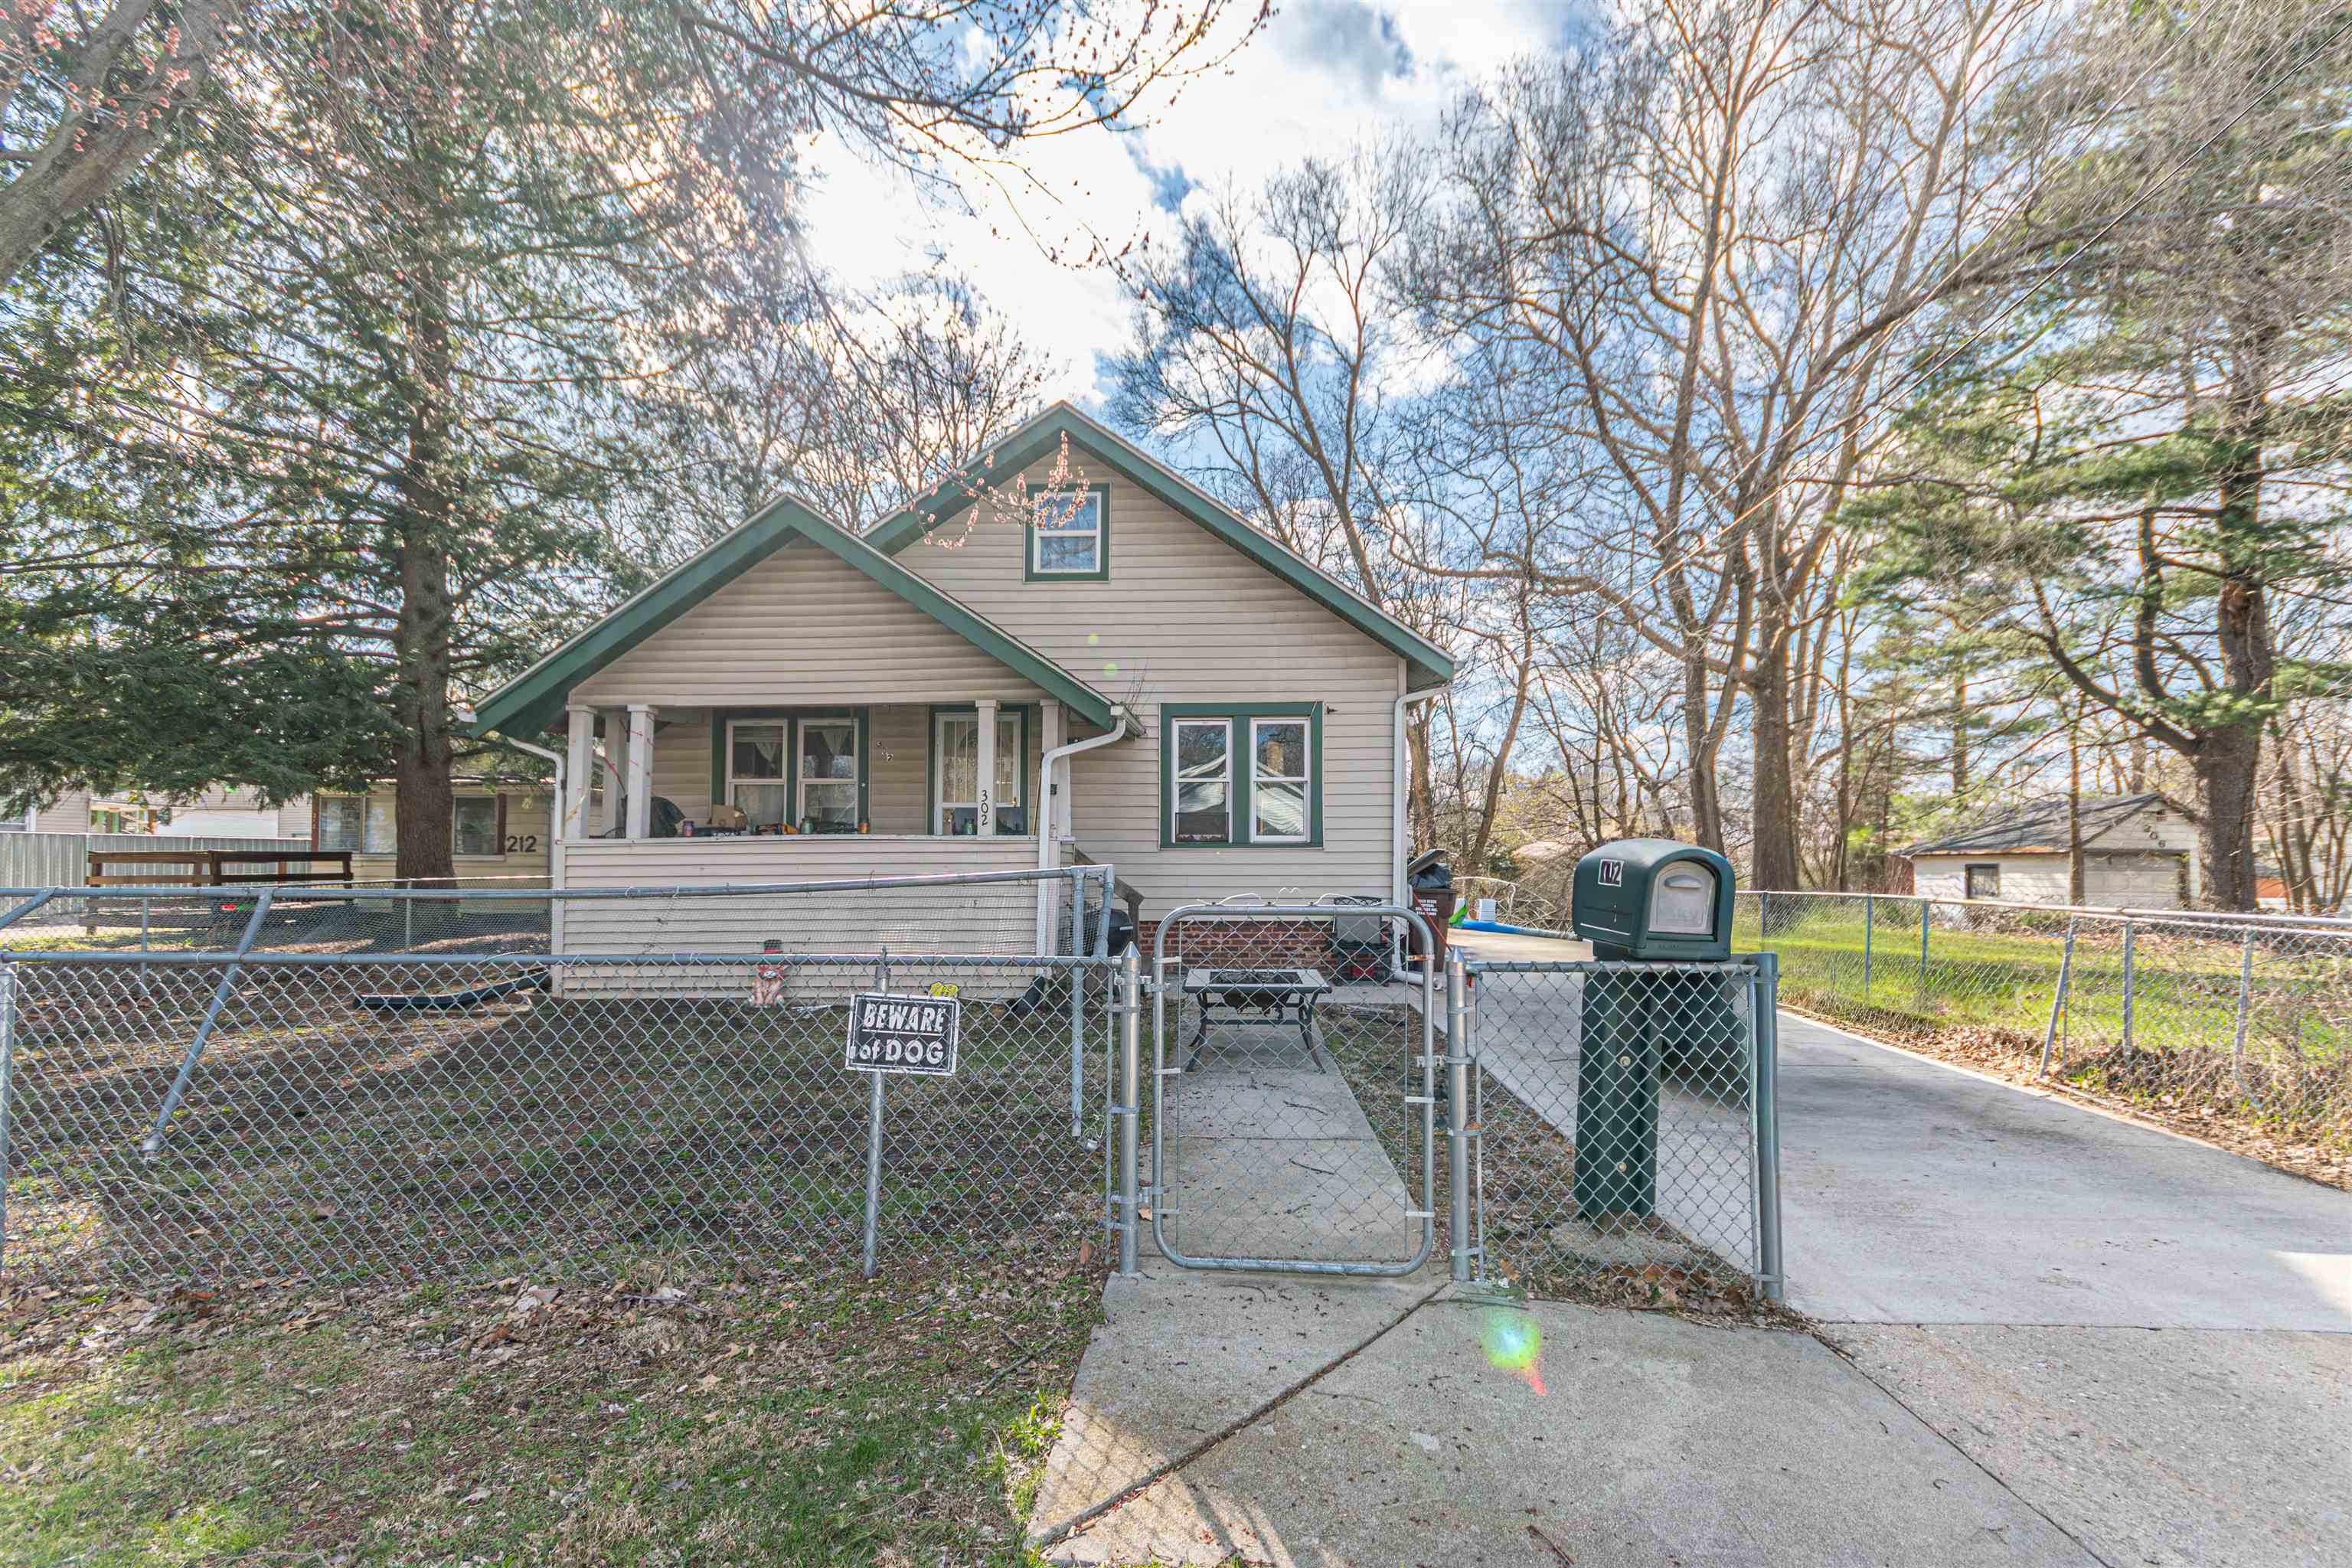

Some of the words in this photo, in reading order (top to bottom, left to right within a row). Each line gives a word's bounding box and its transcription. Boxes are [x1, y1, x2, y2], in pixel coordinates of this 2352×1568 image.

[506, 835, 537, 853] 212
[863, 1003, 947, 1033] BEWARE
[859, 1039, 880, 1060] of
[885, 1039, 944, 1065] DOG
